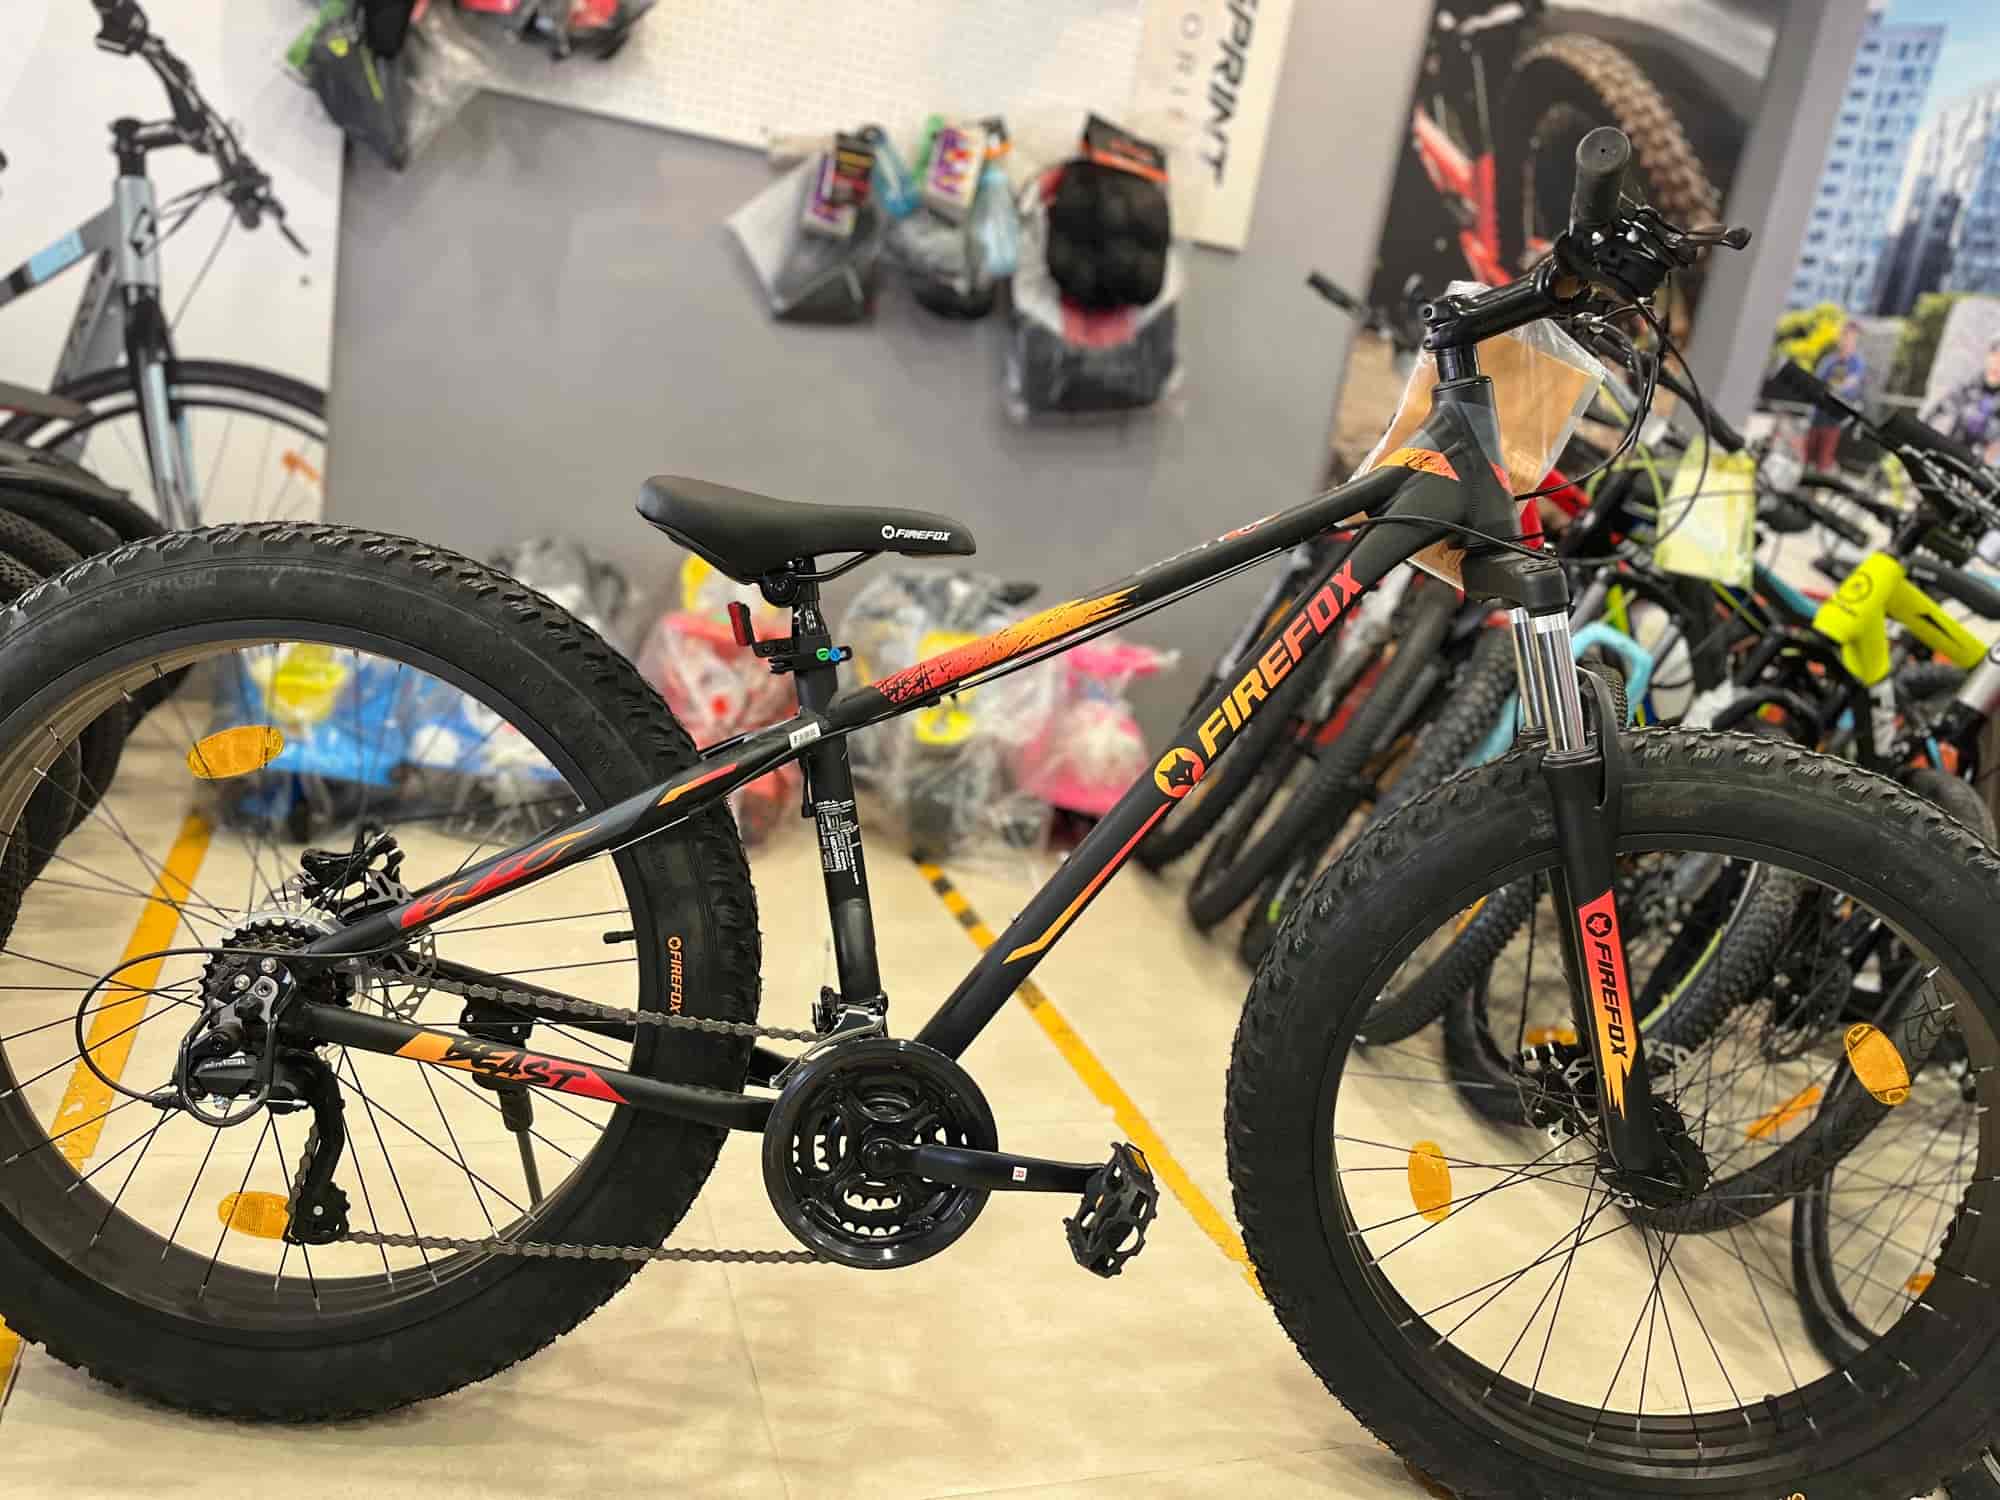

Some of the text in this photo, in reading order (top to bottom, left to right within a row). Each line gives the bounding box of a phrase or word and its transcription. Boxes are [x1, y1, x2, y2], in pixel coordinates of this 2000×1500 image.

[895, 528, 952, 541] FIREFOX
[1198, 559, 1364, 759] FIREFOX
[669, 950, 683, 1015] FIREFOX
[1594, 941, 1628, 1060] FIREFOX
[438, 1037, 588, 1090] BEAST
